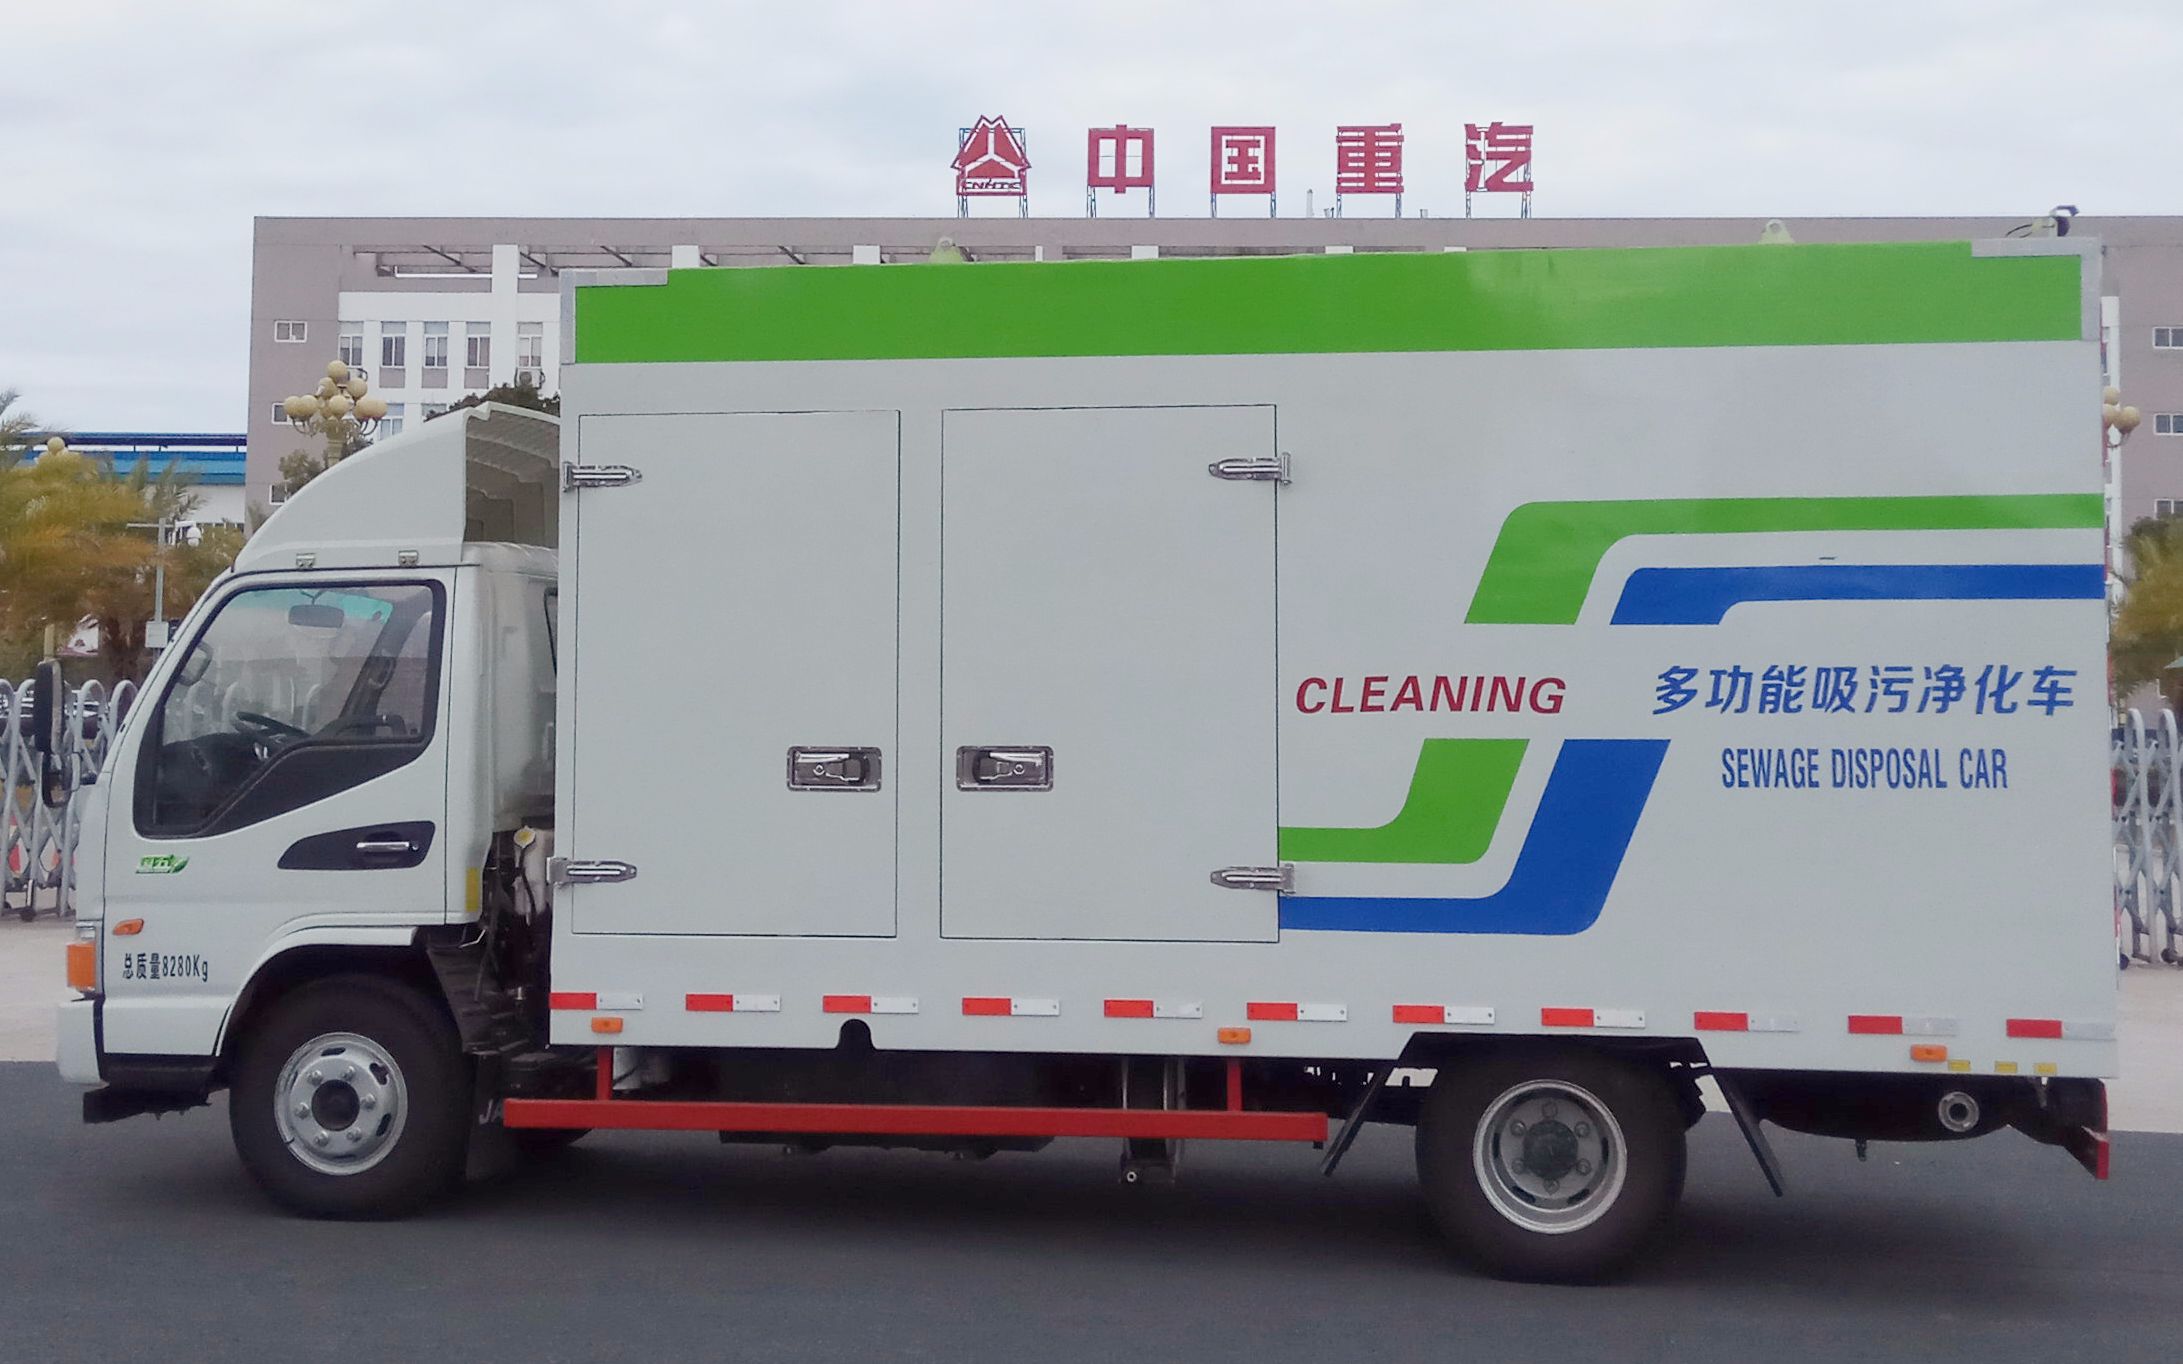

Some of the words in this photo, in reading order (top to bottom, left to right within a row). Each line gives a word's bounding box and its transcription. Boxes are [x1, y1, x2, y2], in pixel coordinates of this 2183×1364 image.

[1087, 122, 1534, 194] 中国重汽
[1295, 674, 1567, 714] CLEANING
[1652, 663, 2079, 716] 多功能吸污净化车
[1721, 747, 1820, 789] SEWAGE
[1831, 747, 1948, 789] DISPOSAL
[1959, 747, 2009, 789] CAR
